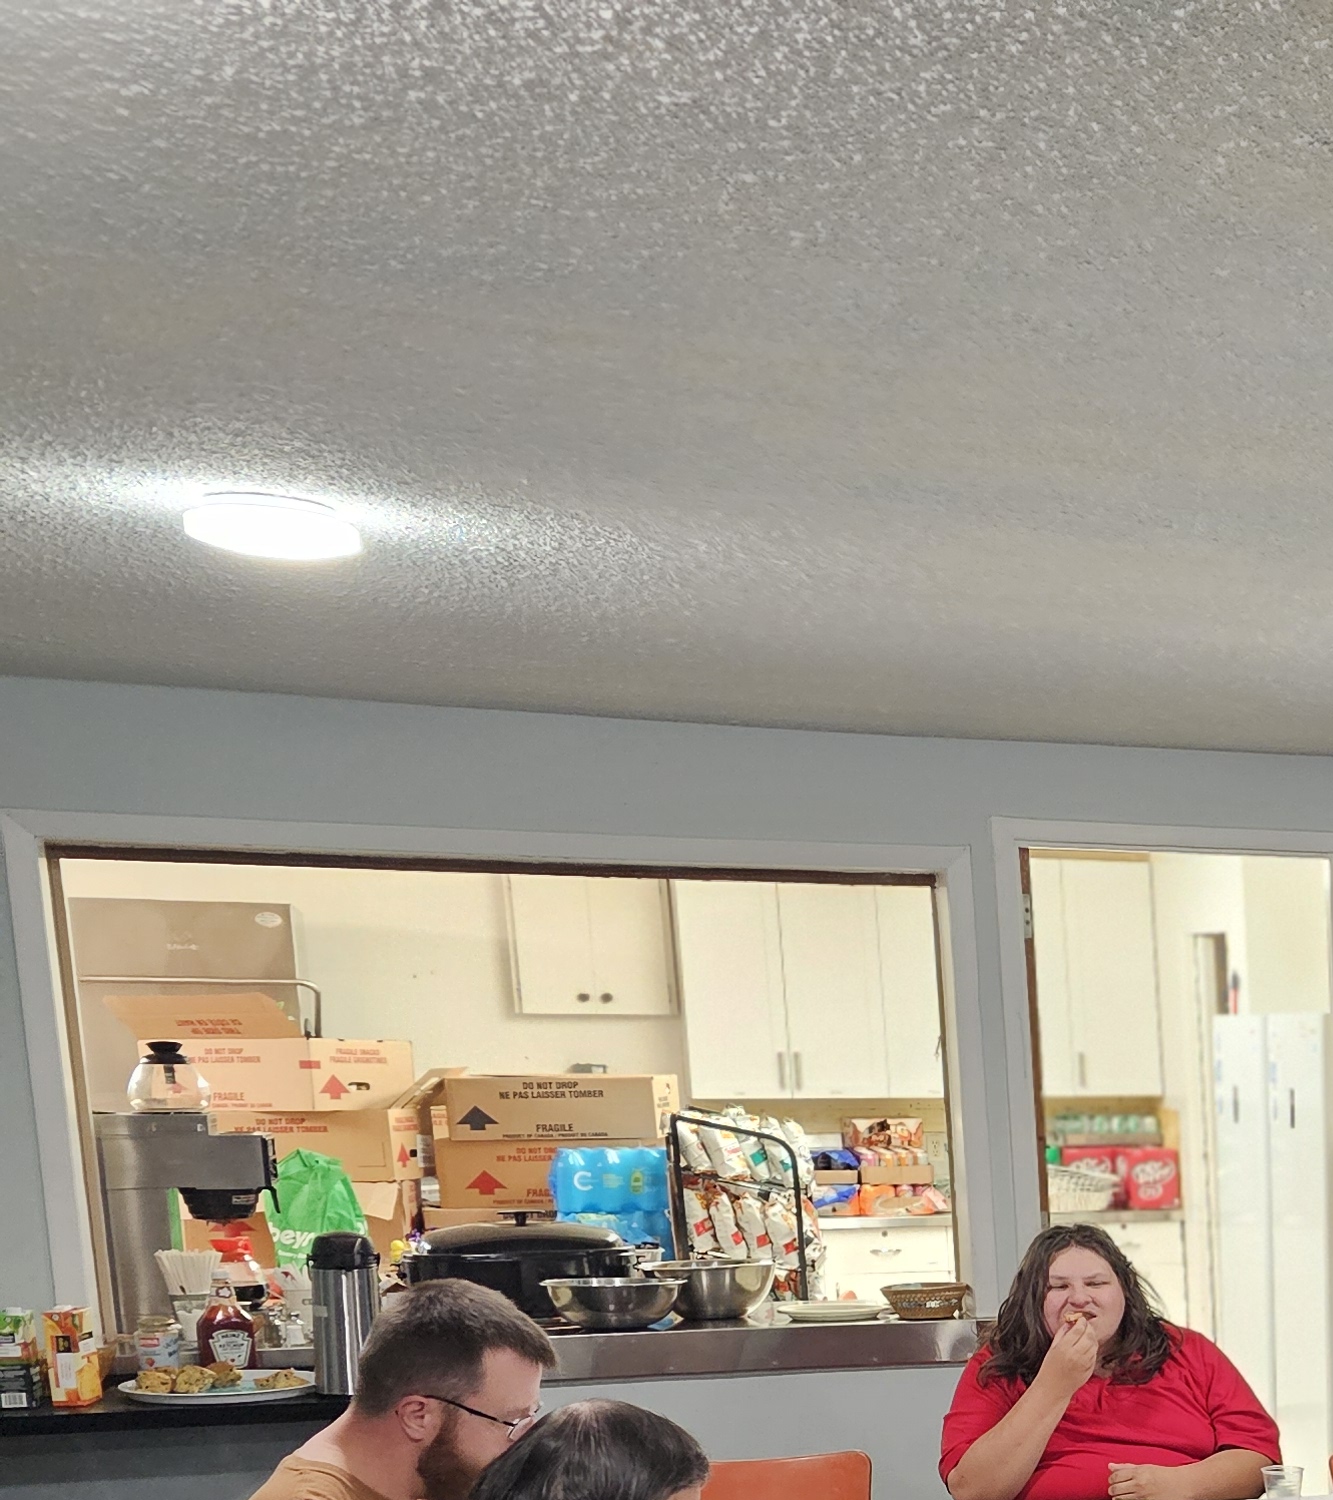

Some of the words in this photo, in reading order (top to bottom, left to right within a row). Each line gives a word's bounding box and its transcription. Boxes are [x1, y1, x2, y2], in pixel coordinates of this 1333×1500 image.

[214, 1047, 226, 1055] NOT
[227, 1047, 244, 1055] DROP
[522, 1081, 535, 1090] DO
[536, 1081, 553, 1090] NOT
[555, 1081, 579, 1089] DROP
[212, 1092, 245, 1101] FRAGILE
[498, 1091, 510, 1100] NE
[512, 1091, 529, 1099] PAS
[531, 1090, 566, 1099] LAISSER
[568, 1089, 604, 1098] TOMBER
[255, 1118, 267, 1126] DO
[268, 1117, 283, 1126] NOT
[285, 1117, 306, 1125] DROP
[535, 1123, 574, 1133] FRAGILE
